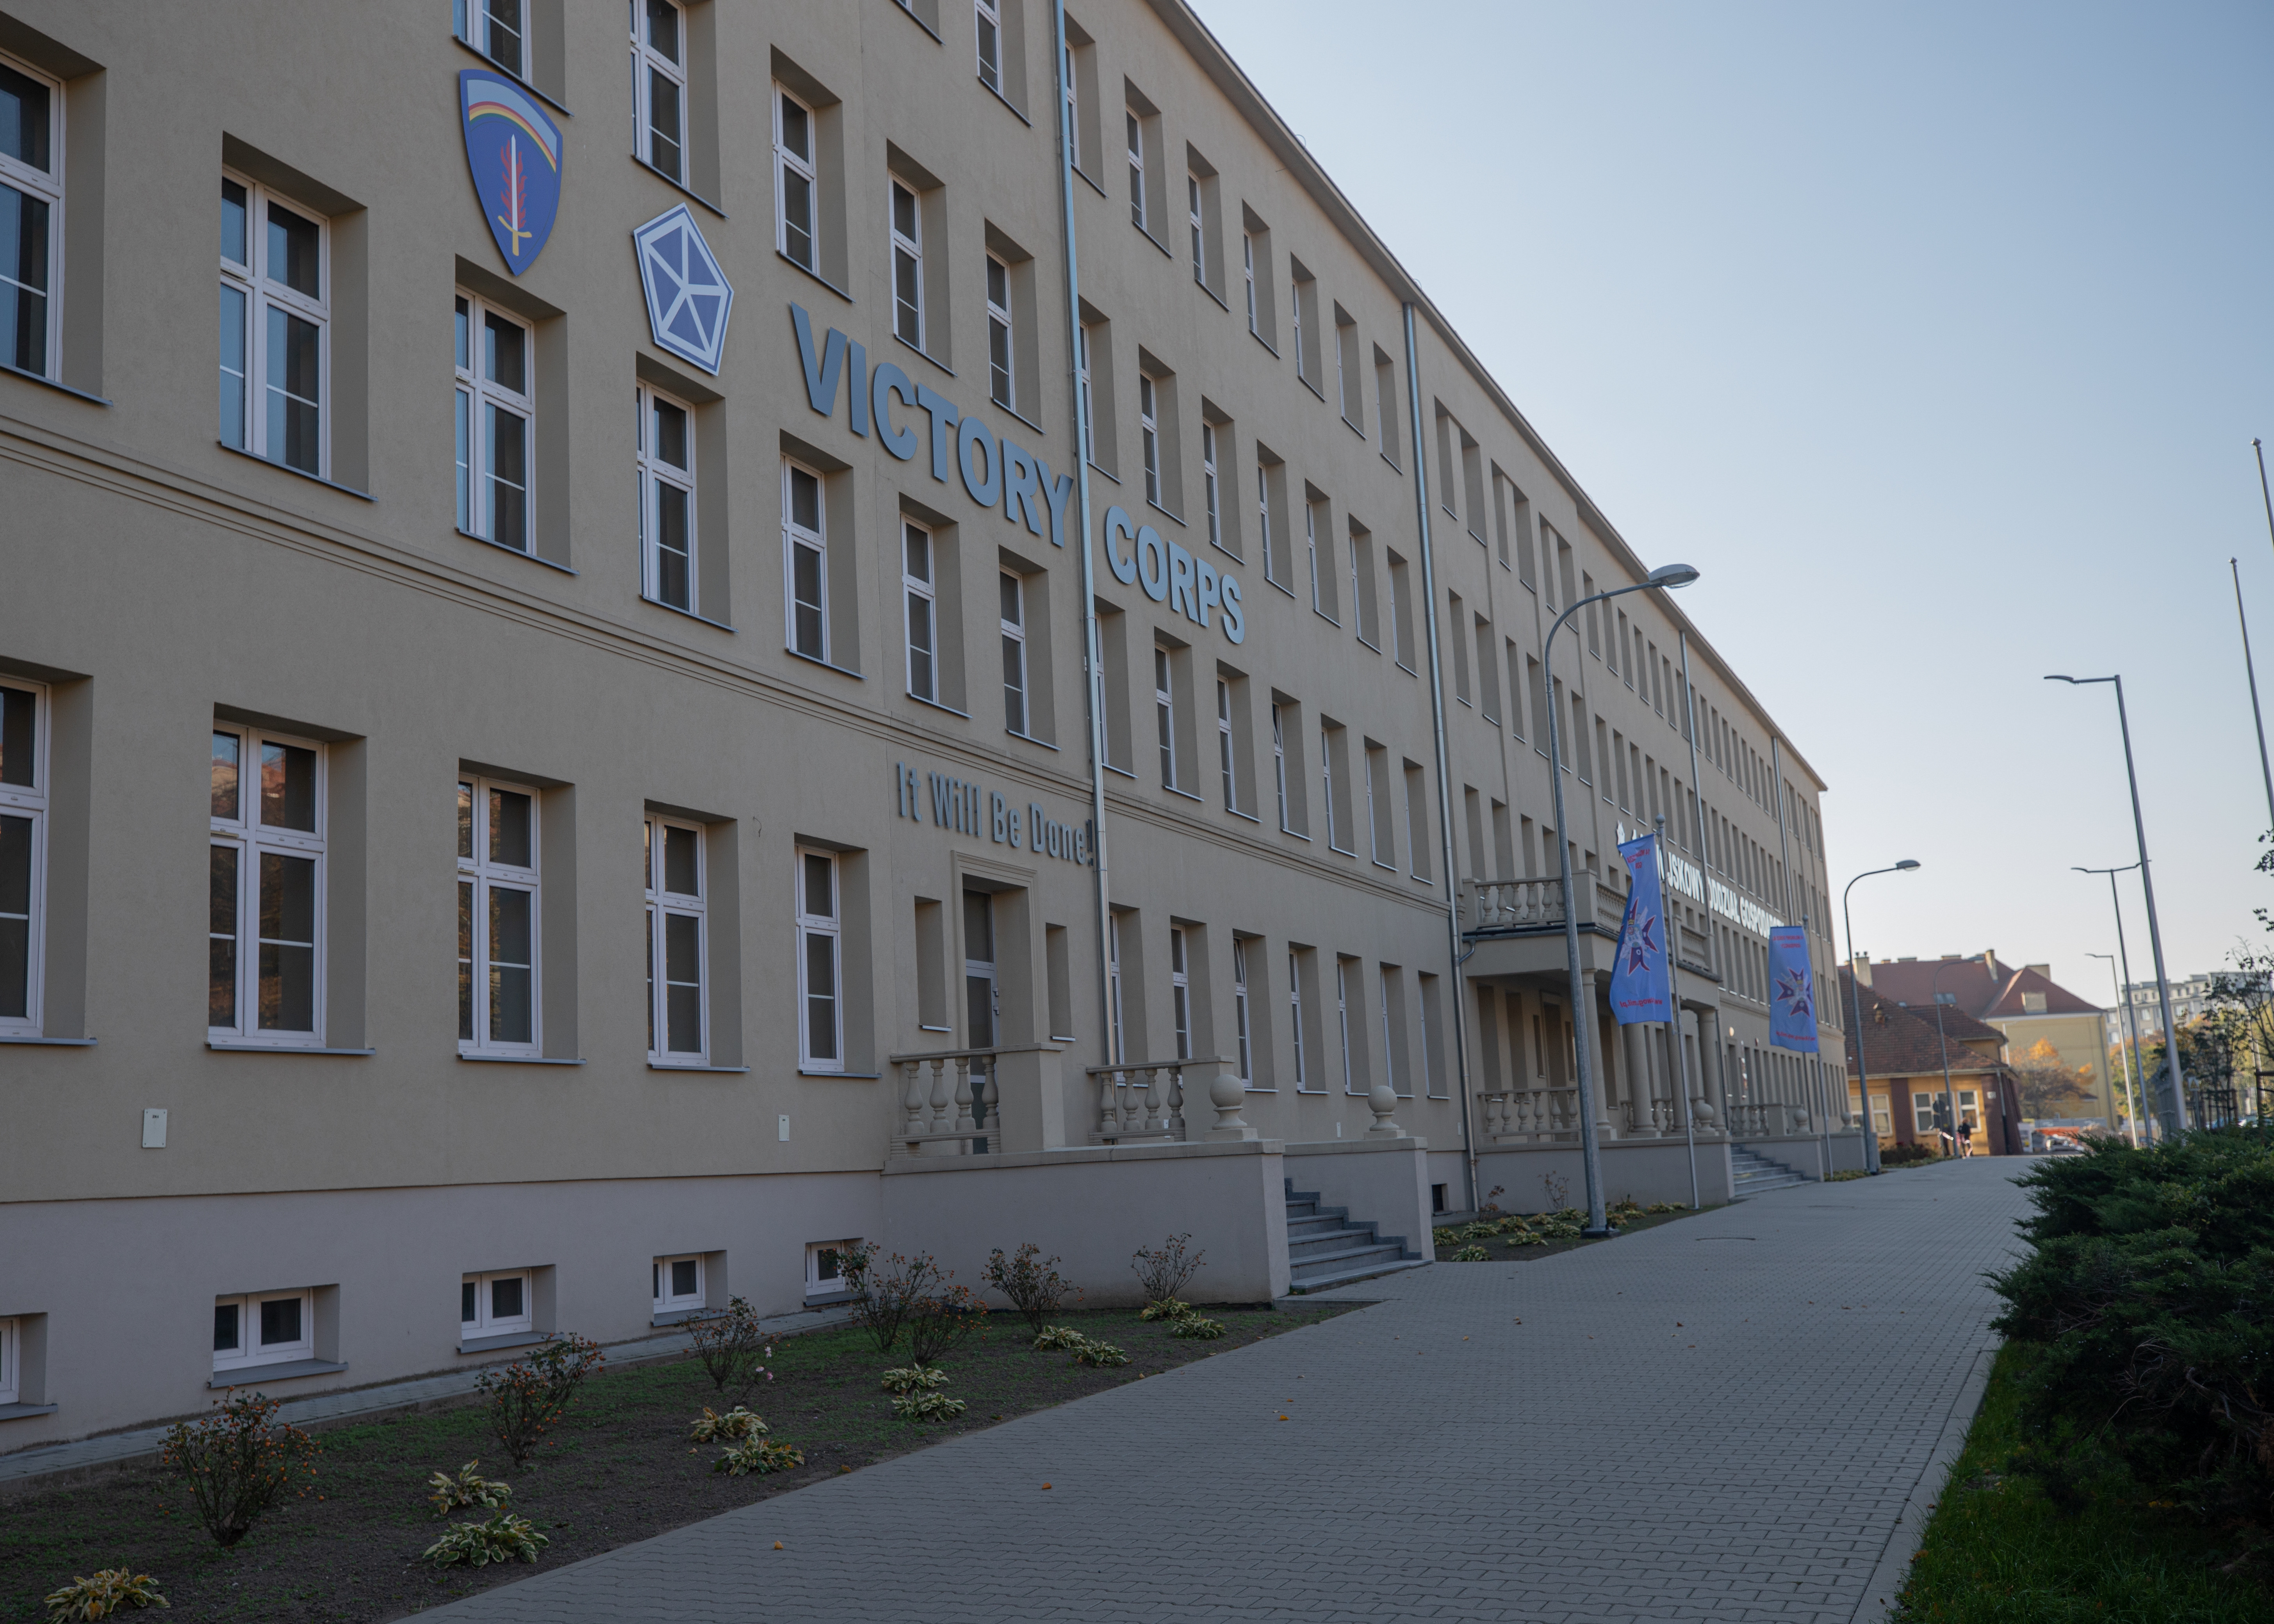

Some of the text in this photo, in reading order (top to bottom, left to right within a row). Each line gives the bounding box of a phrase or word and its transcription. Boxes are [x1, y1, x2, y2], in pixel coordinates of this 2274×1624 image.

[790, 301, 1245, 645] VICTORY CORPS
[899, 761, 1093, 866] It Will Be Done!
